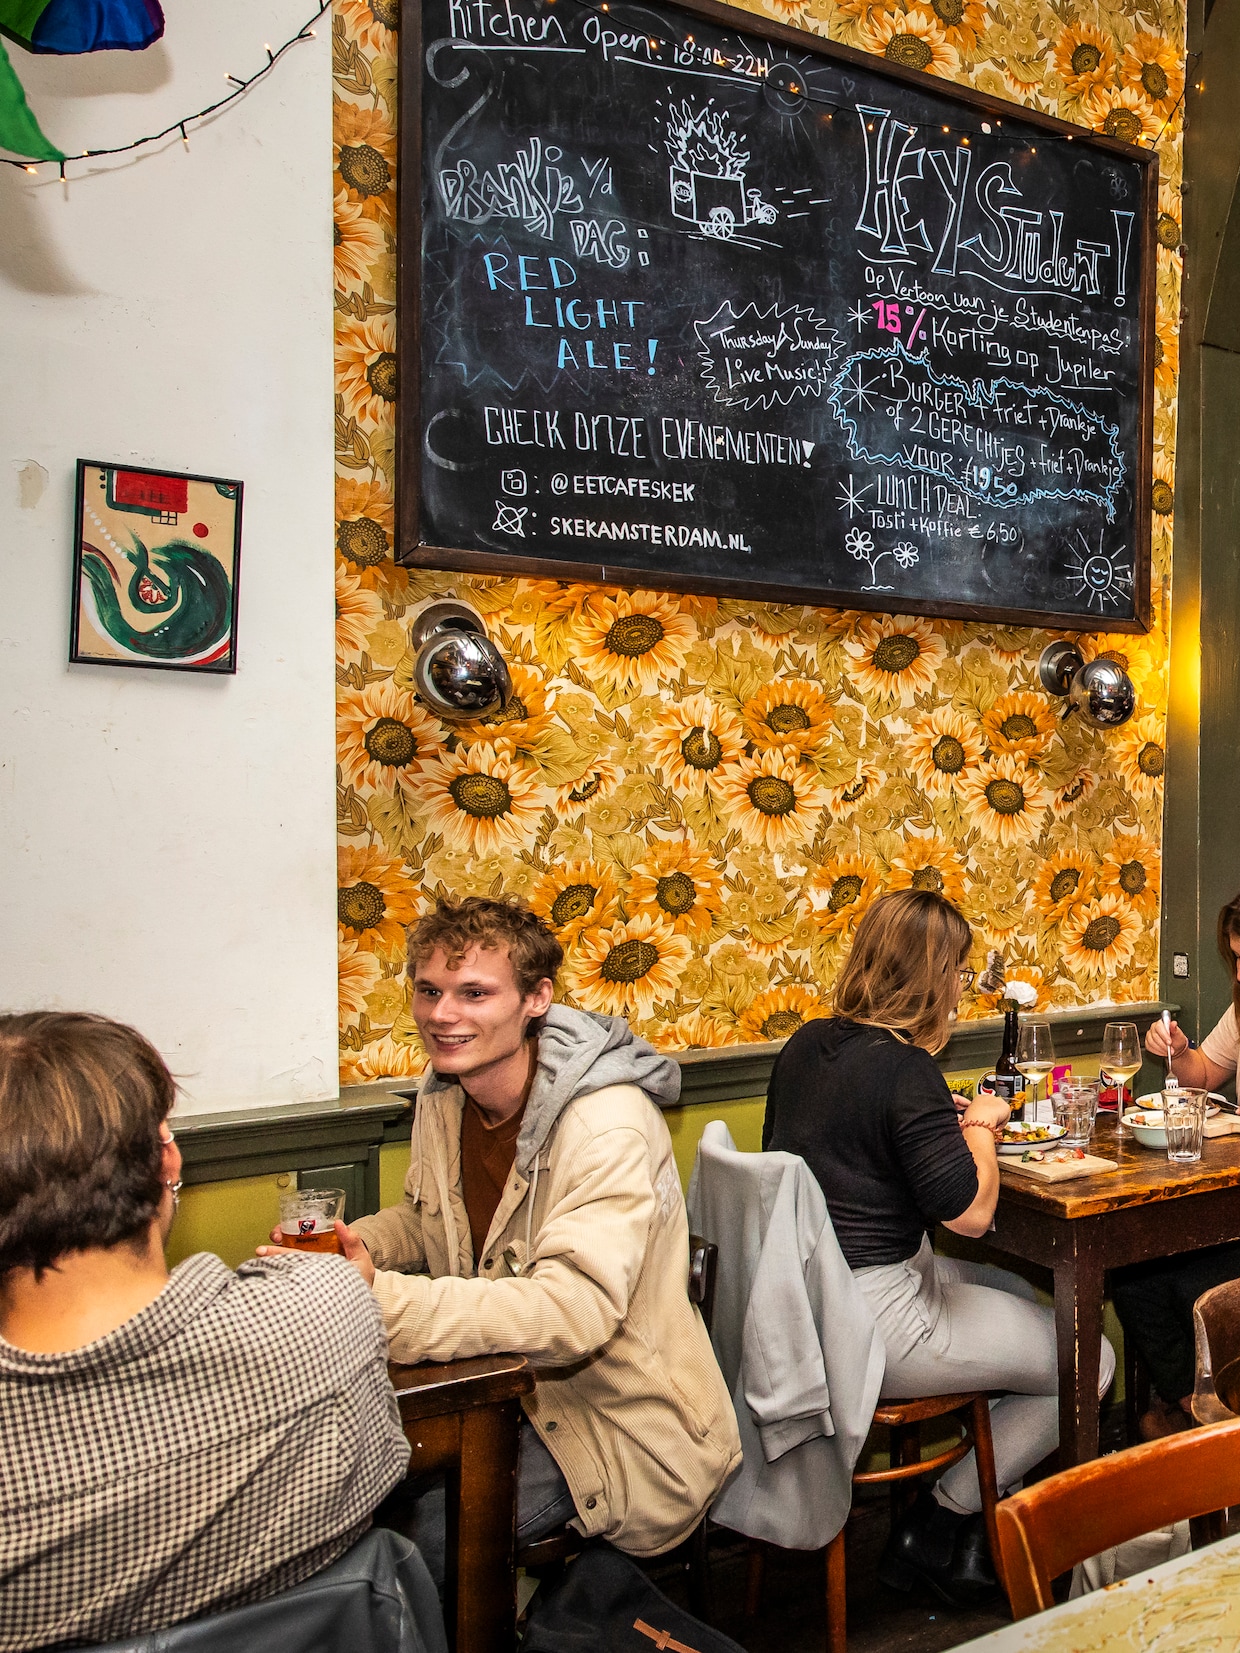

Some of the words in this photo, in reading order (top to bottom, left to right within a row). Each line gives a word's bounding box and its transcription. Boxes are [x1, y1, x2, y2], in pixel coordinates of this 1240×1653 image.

[450, 0, 567, 43] Kitchen
[855, 103, 972, 276] HEY
[484, 252, 578, 291] RED
[525, 296, 645, 330] LIGHT
[865, 267, 884, 291] Op
[888, 267, 950, 305] Vertoon
[953, 292, 986, 311] van
[977, 300, 1009, 331] je
[709, 325, 776, 358] Thursday
[790, 317, 832, 357] Sunday
[932, 316, 1012, 366] Korting
[1016, 351, 1040, 377] op
[1046, 345, 1116, 386] Jupiler
[557, 338, 659, 376] ALE!
[725, 357, 764, 389] Live
[765, 359, 822, 381] Music!
[885, 400, 904, 431] of
[909, 407, 926, 434] 2
[1046, 406, 1097, 442] Drankje
[484, 406, 567, 450] CHECK
[661, 417, 815, 468] EVENEMENTEN!
[550, 516, 749, 552] SKEKAMSTERDAM.NL
[868, 509, 905, 530] Tosti
